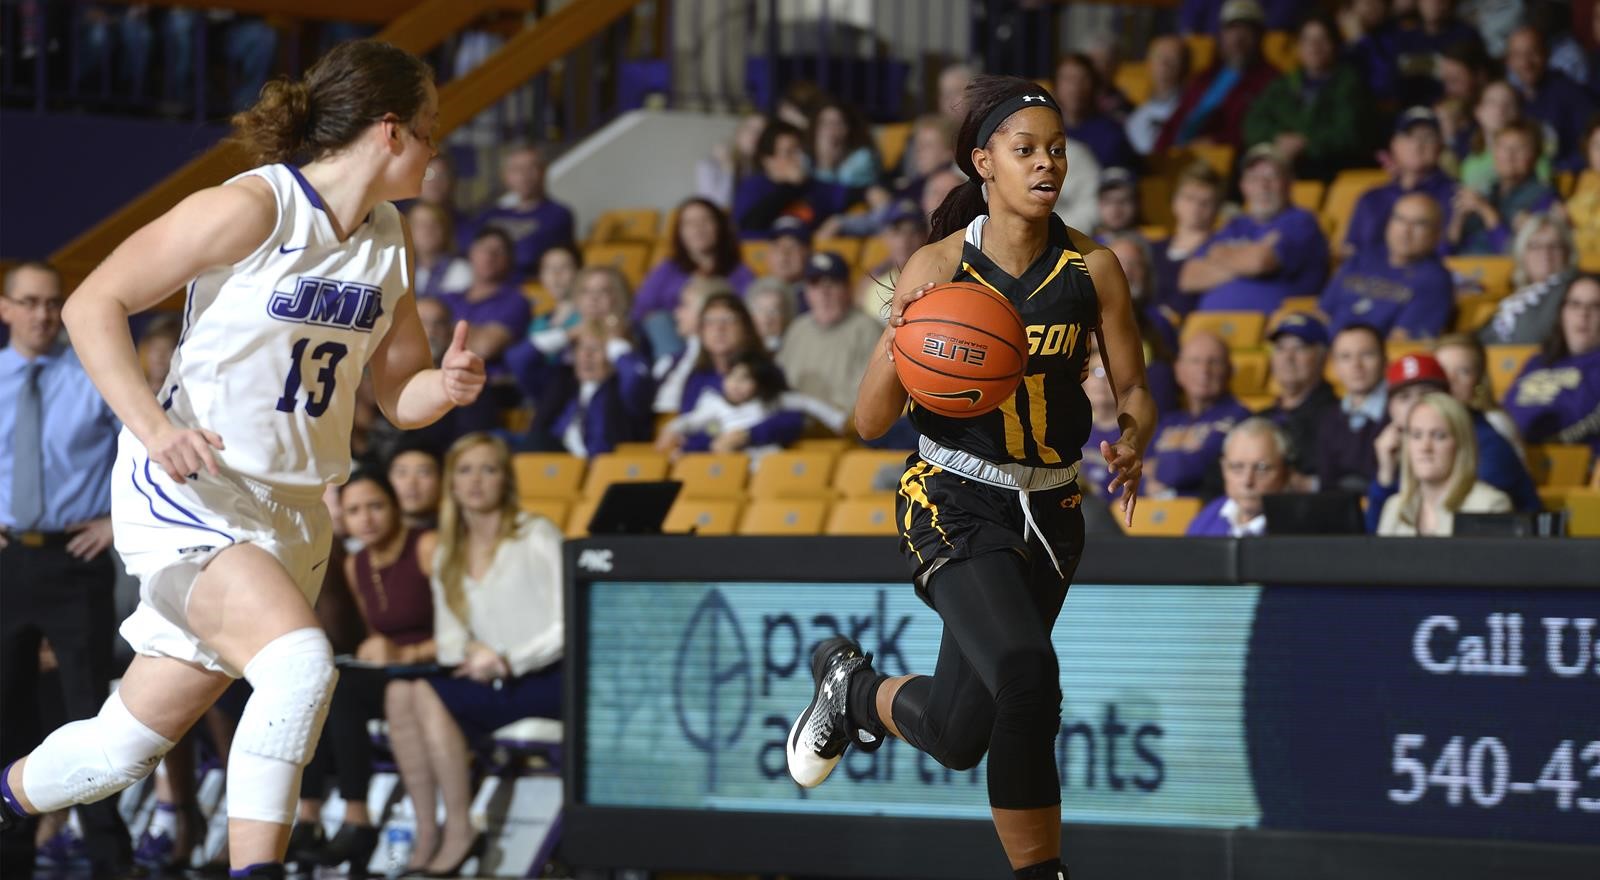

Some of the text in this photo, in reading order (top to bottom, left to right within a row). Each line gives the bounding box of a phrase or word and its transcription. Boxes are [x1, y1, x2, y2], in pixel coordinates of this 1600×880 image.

[267, 276, 384, 333] JMU
[276, 338, 349, 417] 13
[922, 337, 987, 366] ELITE
[998, 373, 1062, 465] 11
[1412, 612, 1600, 677] Call U
[757, 701, 1167, 800] aartnts
